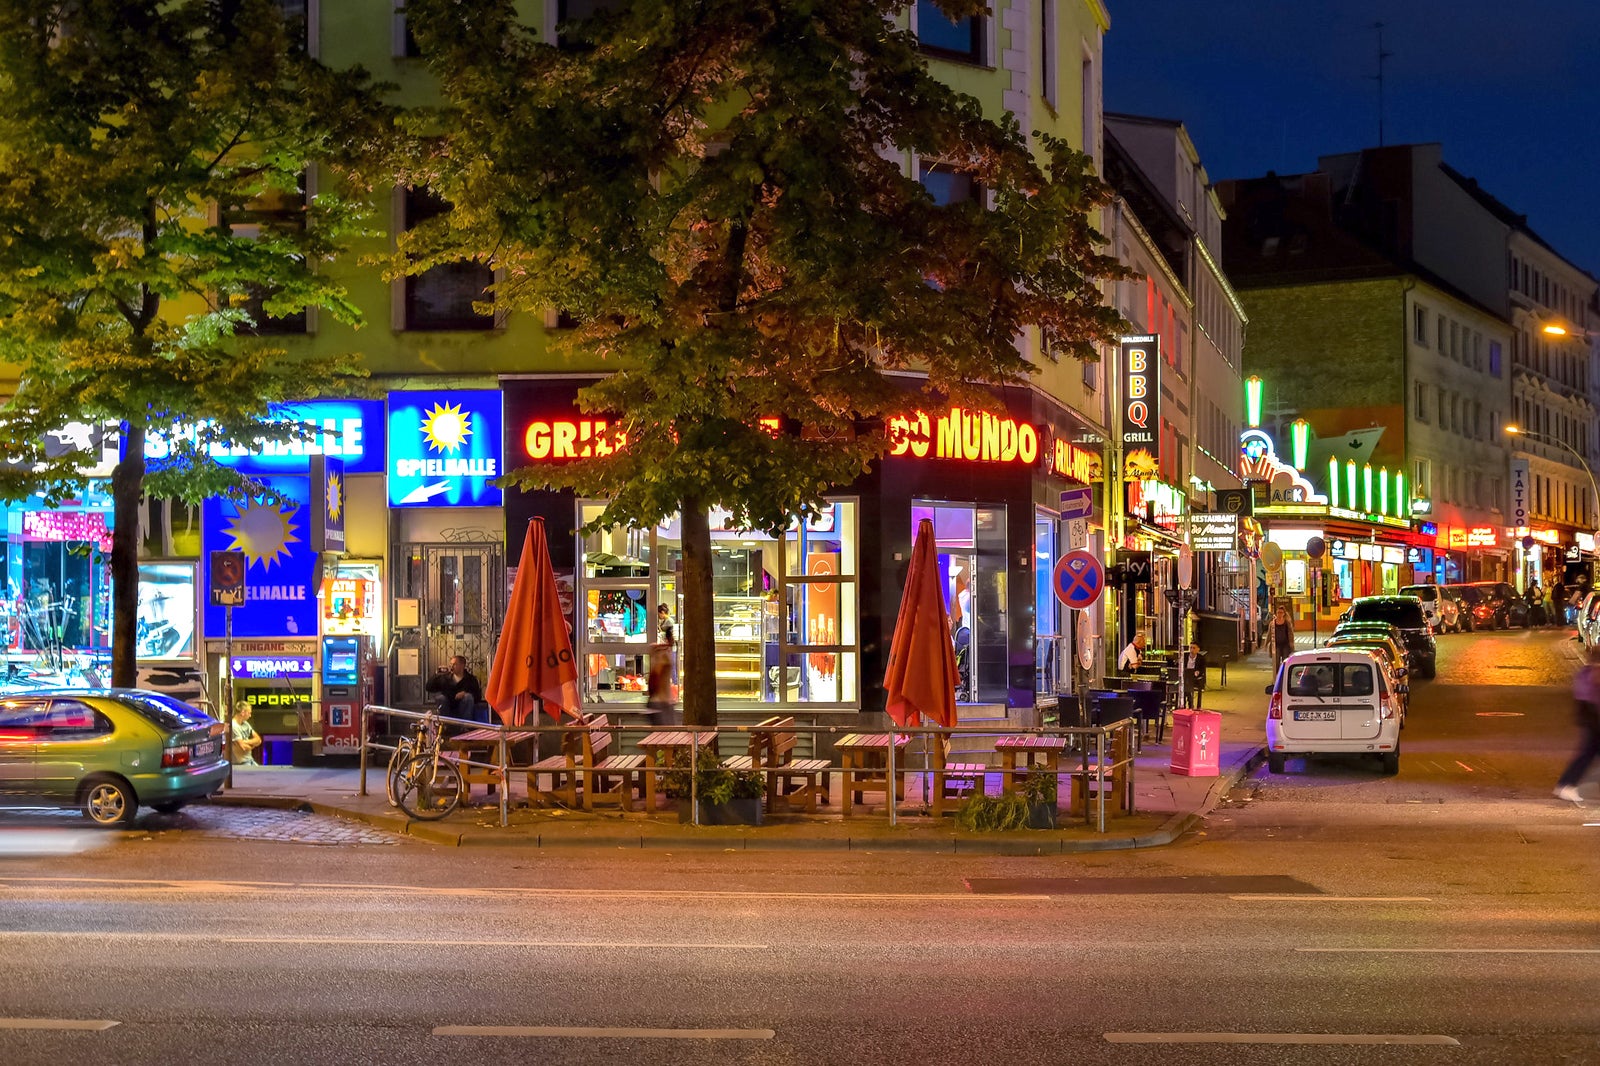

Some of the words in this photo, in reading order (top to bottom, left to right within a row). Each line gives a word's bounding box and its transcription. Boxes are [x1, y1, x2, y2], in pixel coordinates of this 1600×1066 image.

[1128, 349, 1148, 428] BBQ
[936, 407, 1038, 463] MUNDO
[1123, 432, 1154, 442] GRILL
[396, 458, 496, 477] SPIELHALLE
[1515, 470, 1525, 526] TATTOO
[331, 581, 356, 591] ATM
[241, 643, 285, 652] EINGANG
[247, 661, 299, 672] EINGANG
[325, 734, 360, 748] Cash
